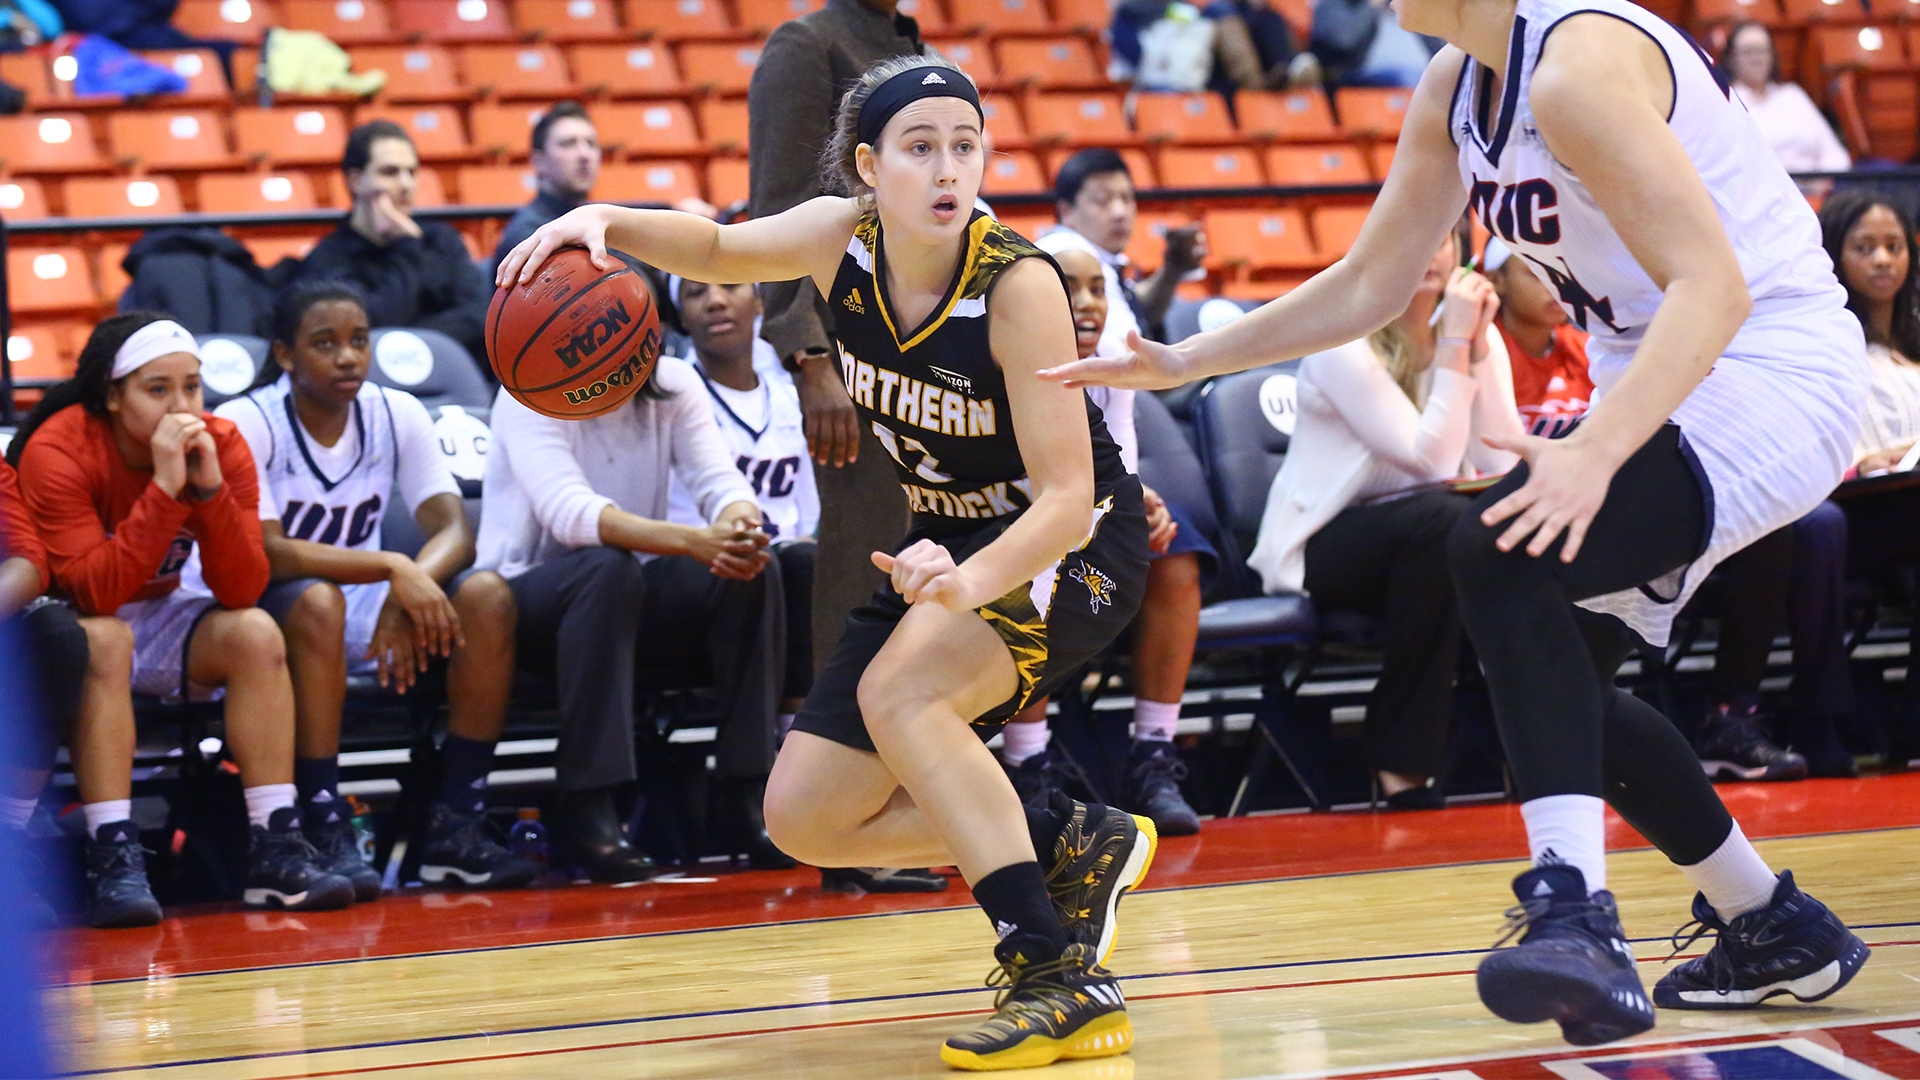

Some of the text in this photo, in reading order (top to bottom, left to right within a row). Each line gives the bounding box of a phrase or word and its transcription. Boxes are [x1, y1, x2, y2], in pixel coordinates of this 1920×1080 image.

[554, 299, 632, 370] NCAA
[563, 327, 659, 405] Wilson
[282, 494, 382, 548] UIC
